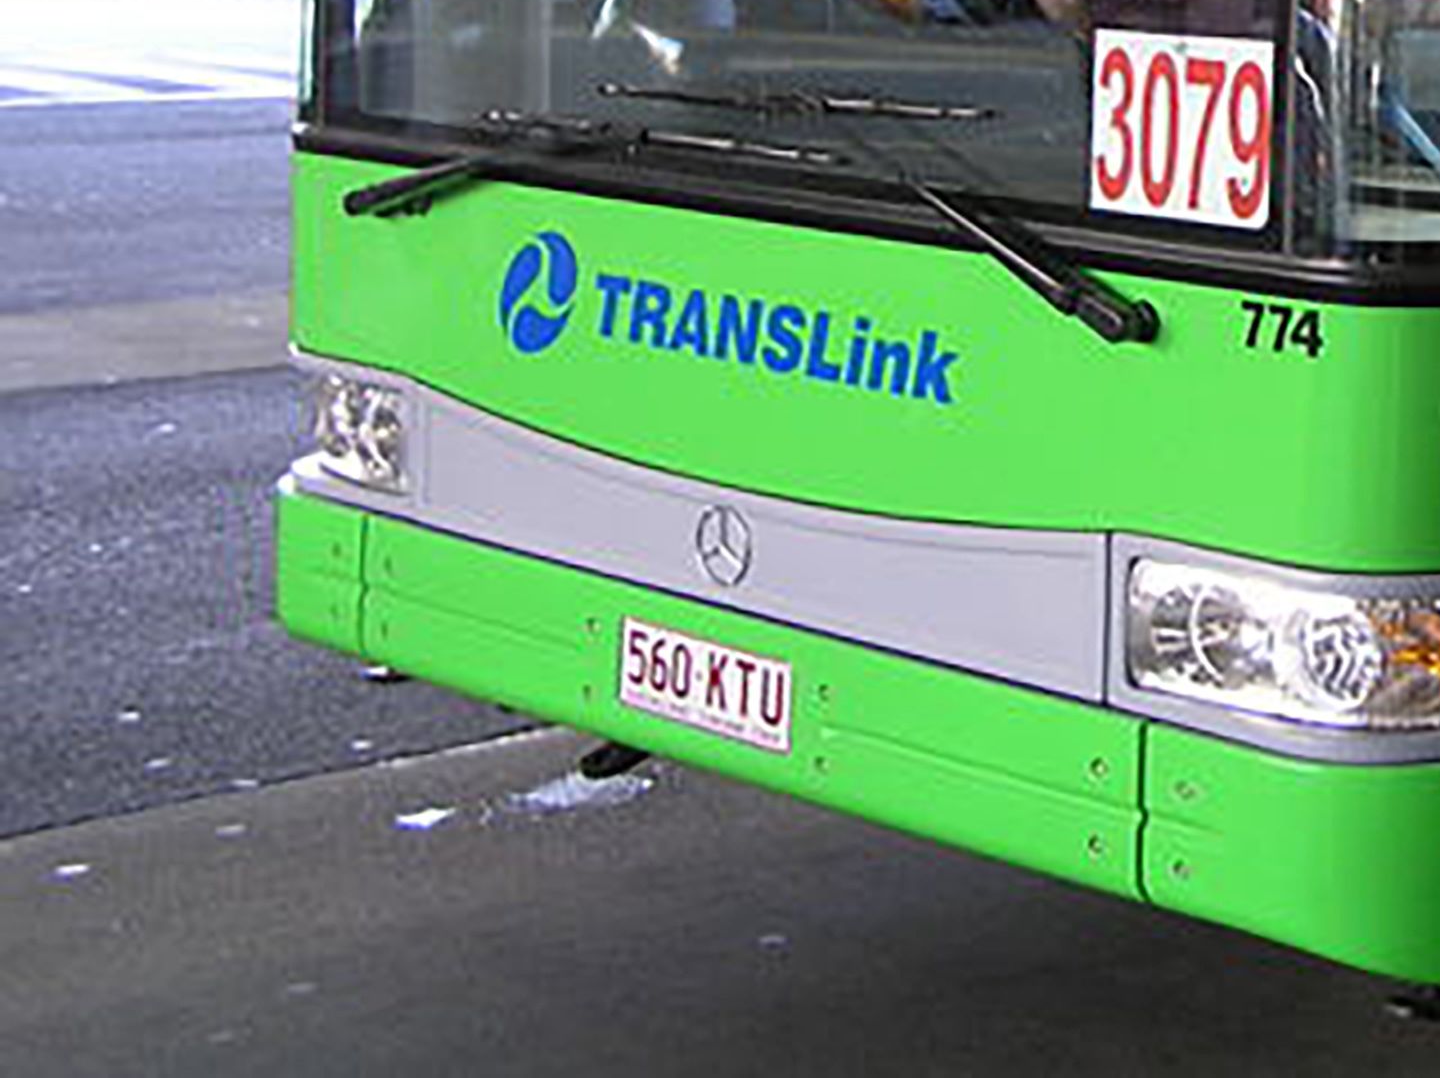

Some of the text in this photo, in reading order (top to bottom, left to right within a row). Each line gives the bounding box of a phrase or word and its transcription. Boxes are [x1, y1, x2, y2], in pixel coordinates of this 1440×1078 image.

[1097, 47, 1271, 219] 3079
[596, 272, 958, 404] TRANSLink
[1241, 300, 1324, 358] 774
